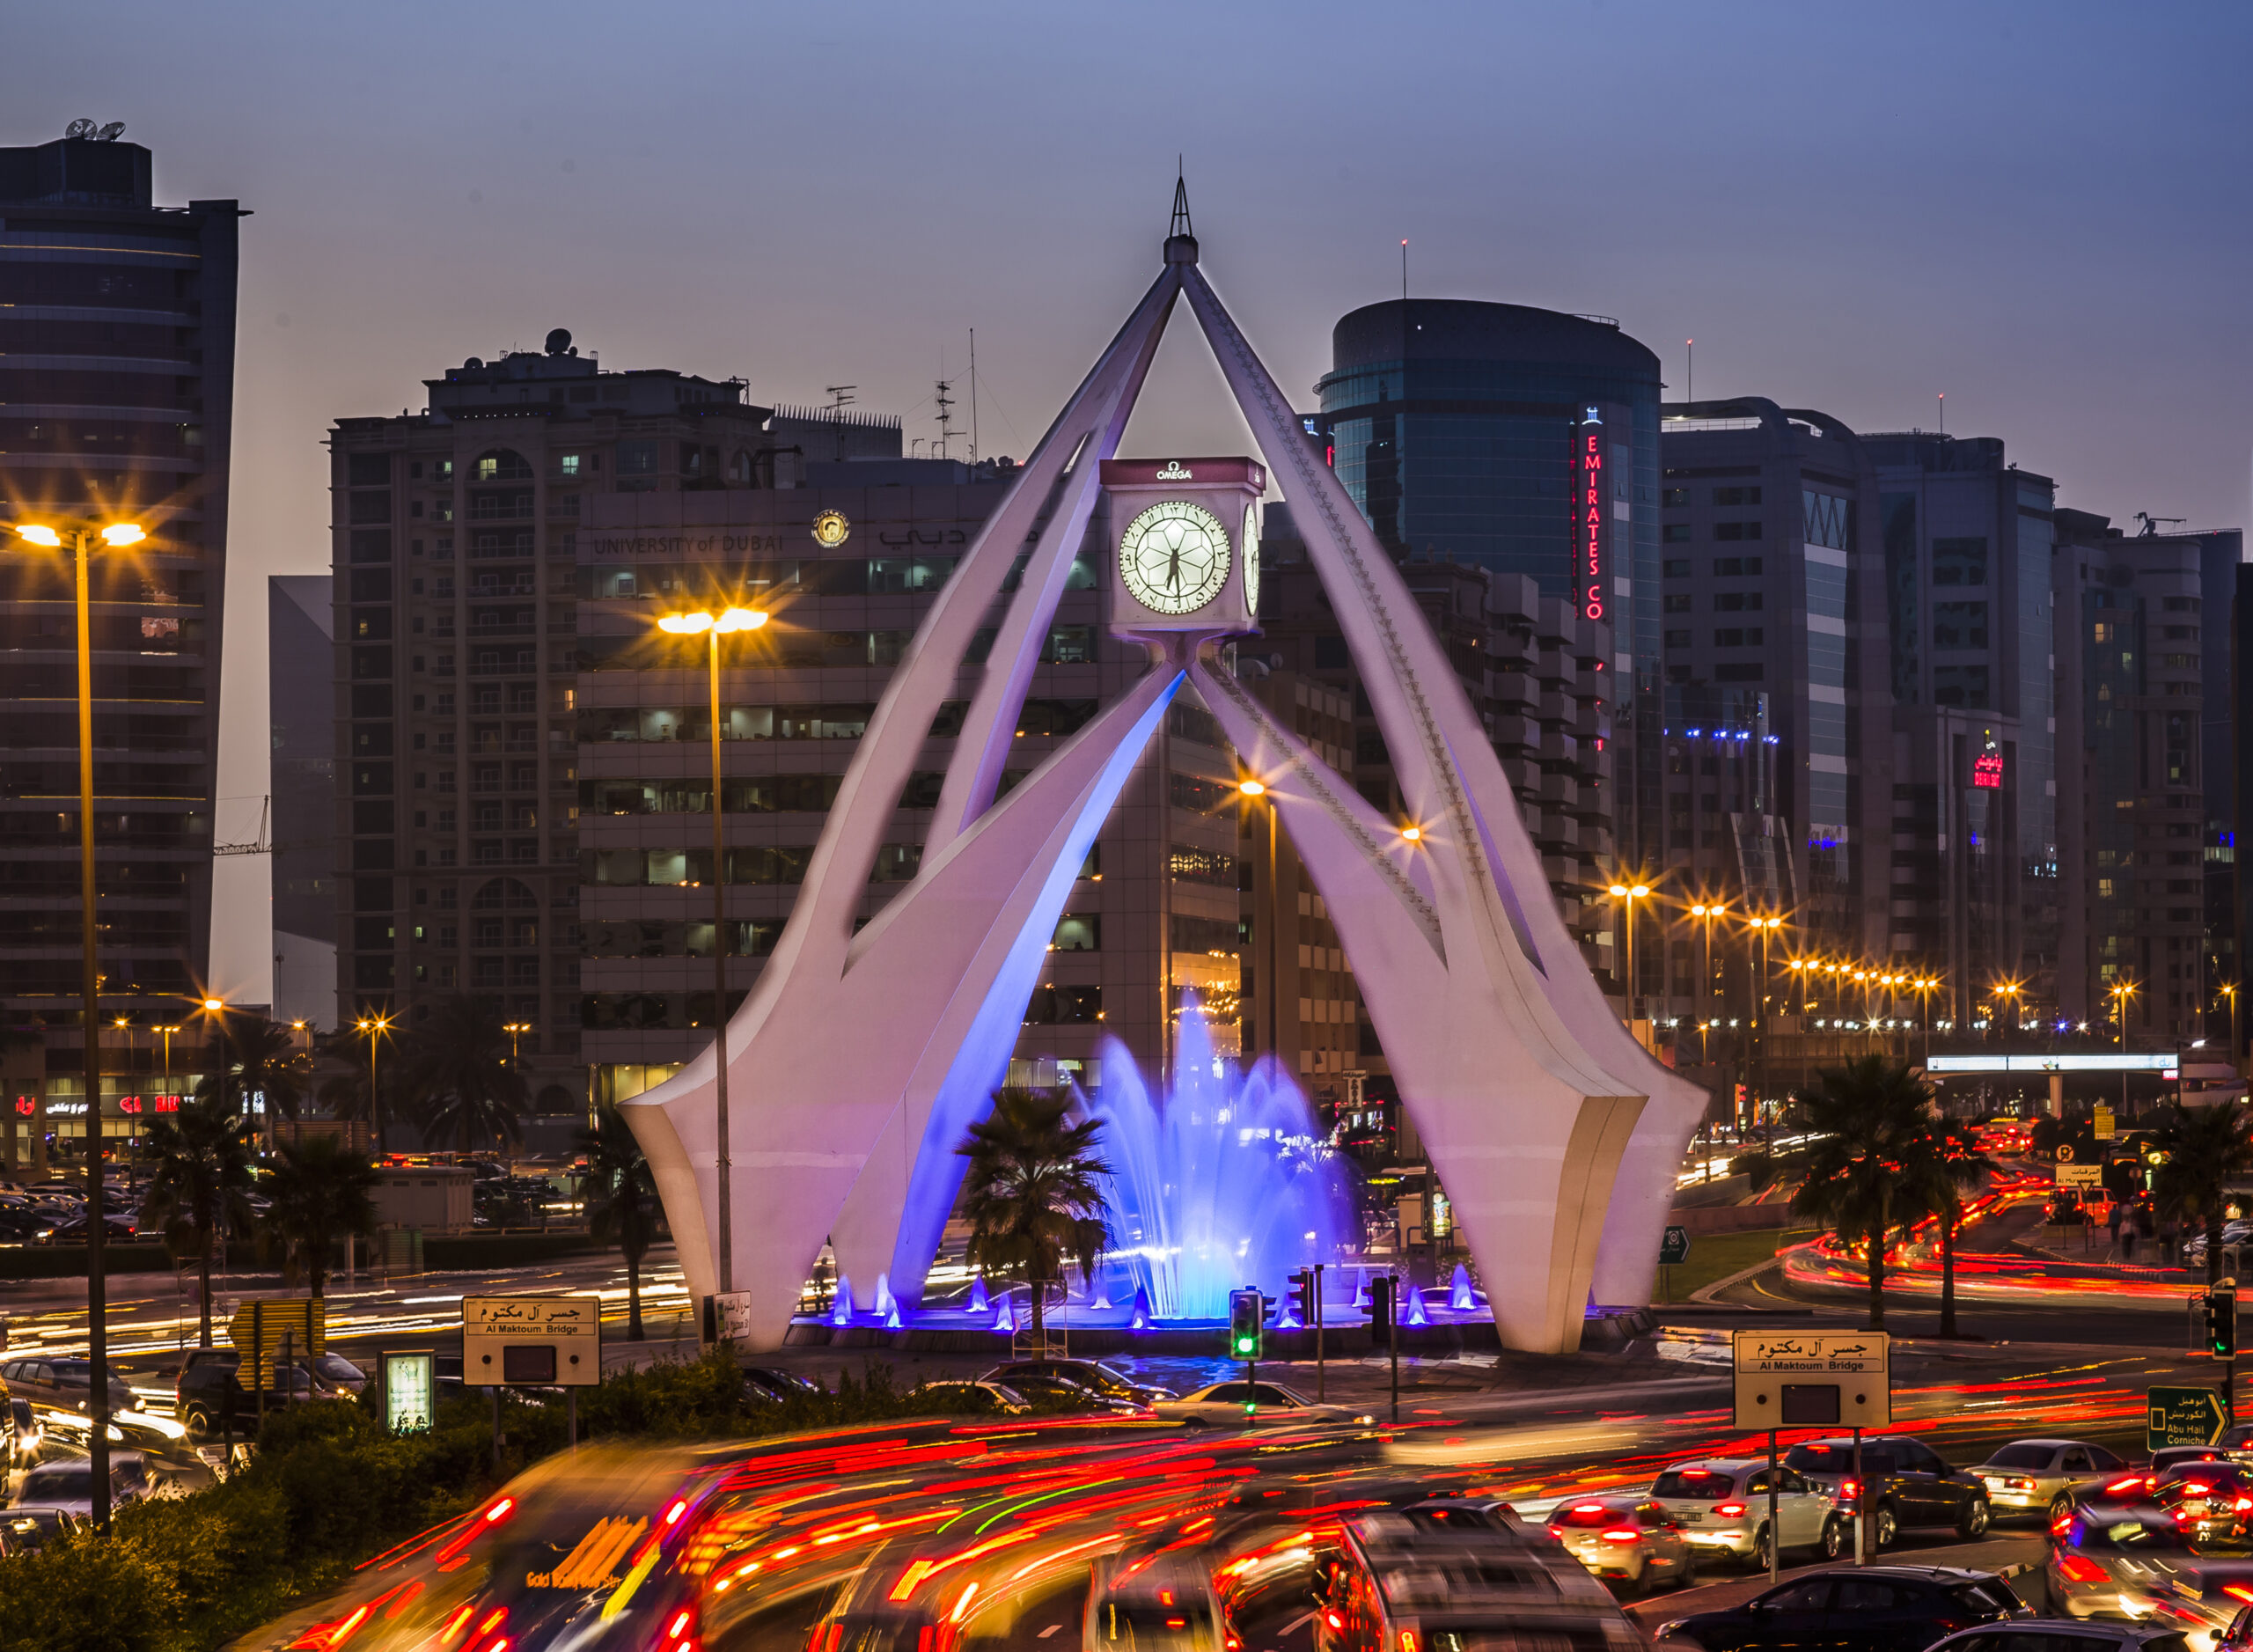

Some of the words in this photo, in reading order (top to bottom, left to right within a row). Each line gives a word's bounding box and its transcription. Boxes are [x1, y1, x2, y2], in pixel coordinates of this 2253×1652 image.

[1156, 470, 1193, 480] OMEGA
[1584, 435, 1602, 576] EMIRATES
[593, 536, 694, 554] UNIVERSITY
[697, 535, 716, 552] of
[722, 534, 783, 552] DUBAI
[879, 529, 965, 550] دبي
[1586, 584, 1604, 620] CO
[481, 1304, 522, 1321] مكتوم
[528, 1303, 542, 1321] آل
[545, 1308, 580, 1321] جسر
[498, 1325, 542, 1333] Maktoum
[547, 1325, 578, 1335] Bridge
[1758, 1340, 1802, 1358] مكتوم
[1809, 1339, 1824, 1357] آل
[1828, 1343, 1868, 1357] جسر
[1760, 1362, 1771, 1370] Al
[1774, 1362, 1823, 1370] Maktoum
[1829, 1361, 1864, 1372] Bridge
[2168, 1424, 2184, 1434] Abu
[2186, 1425, 2205, 1435] Hail
[2167, 1435, 2206, 1445] Corniche
